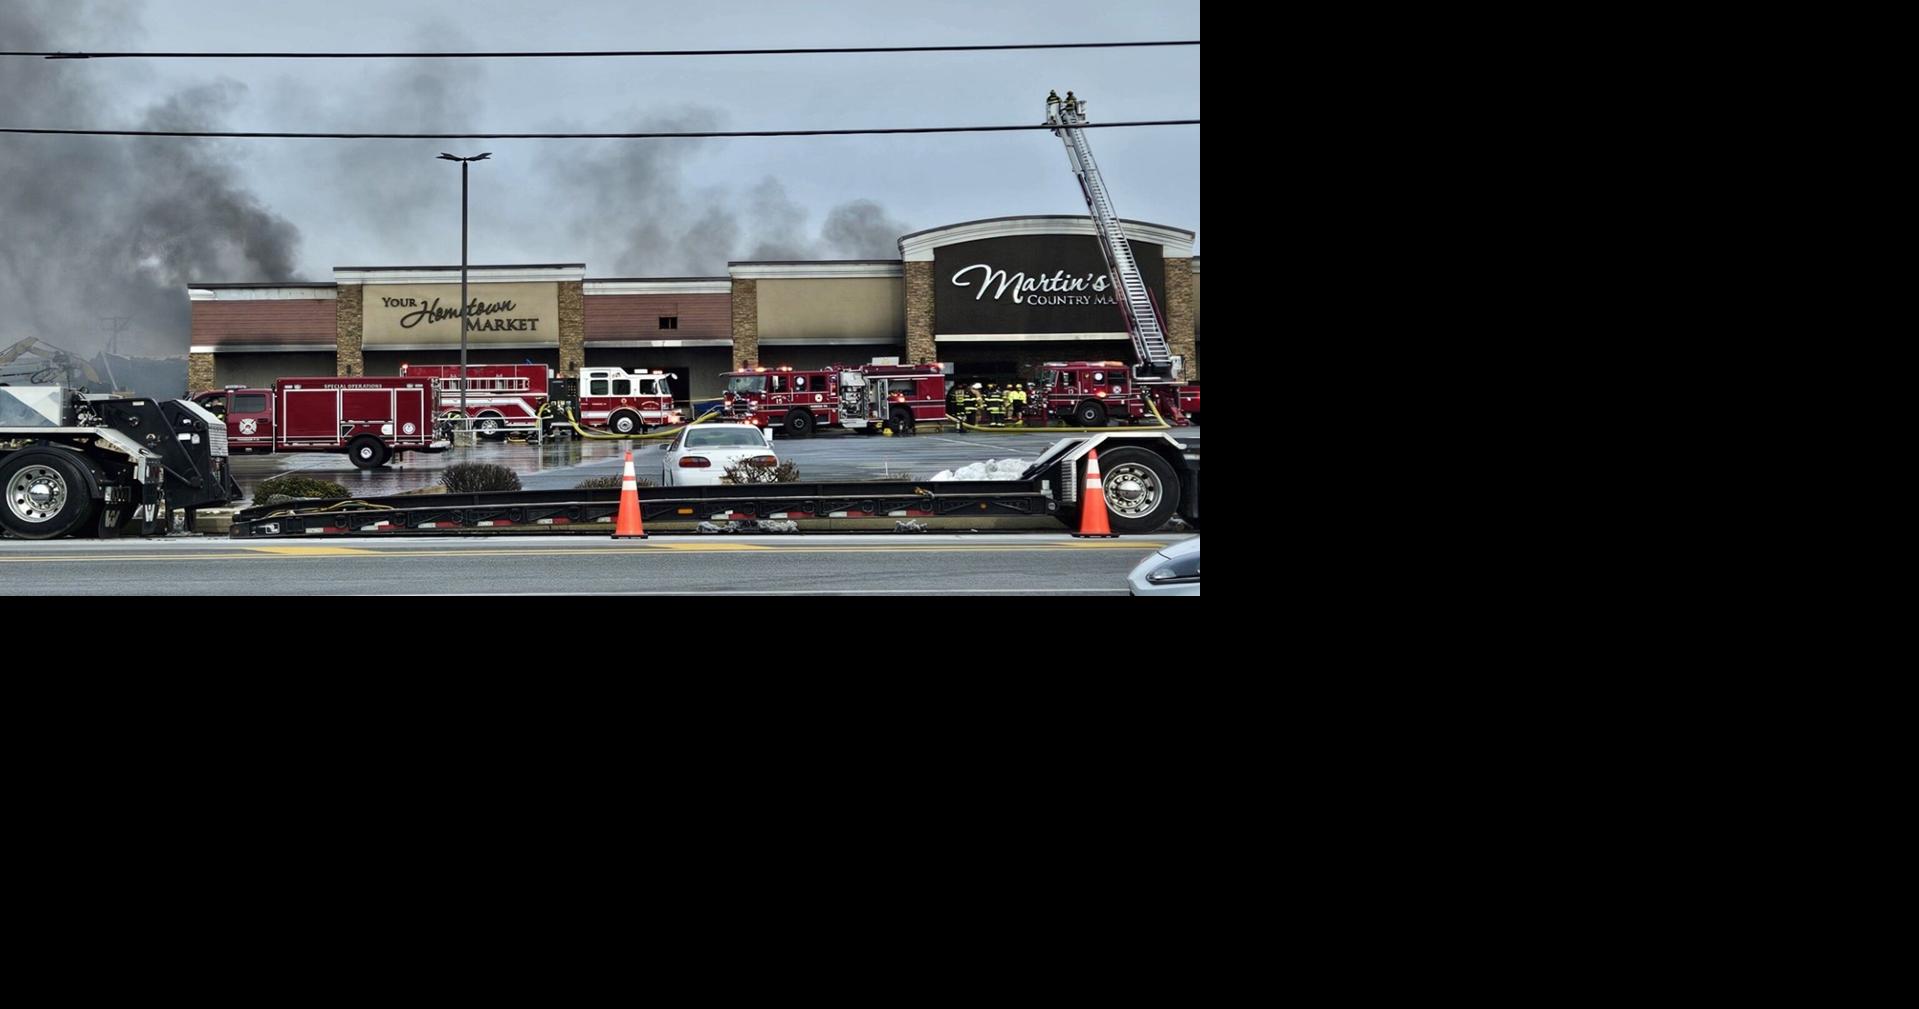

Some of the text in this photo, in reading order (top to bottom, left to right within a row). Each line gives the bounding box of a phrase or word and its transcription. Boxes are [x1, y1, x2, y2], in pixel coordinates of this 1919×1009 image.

[952, 264, 1110, 304] Martin's
[400, 297, 517, 329] Homtown
[466, 317, 539, 332] MARKET
